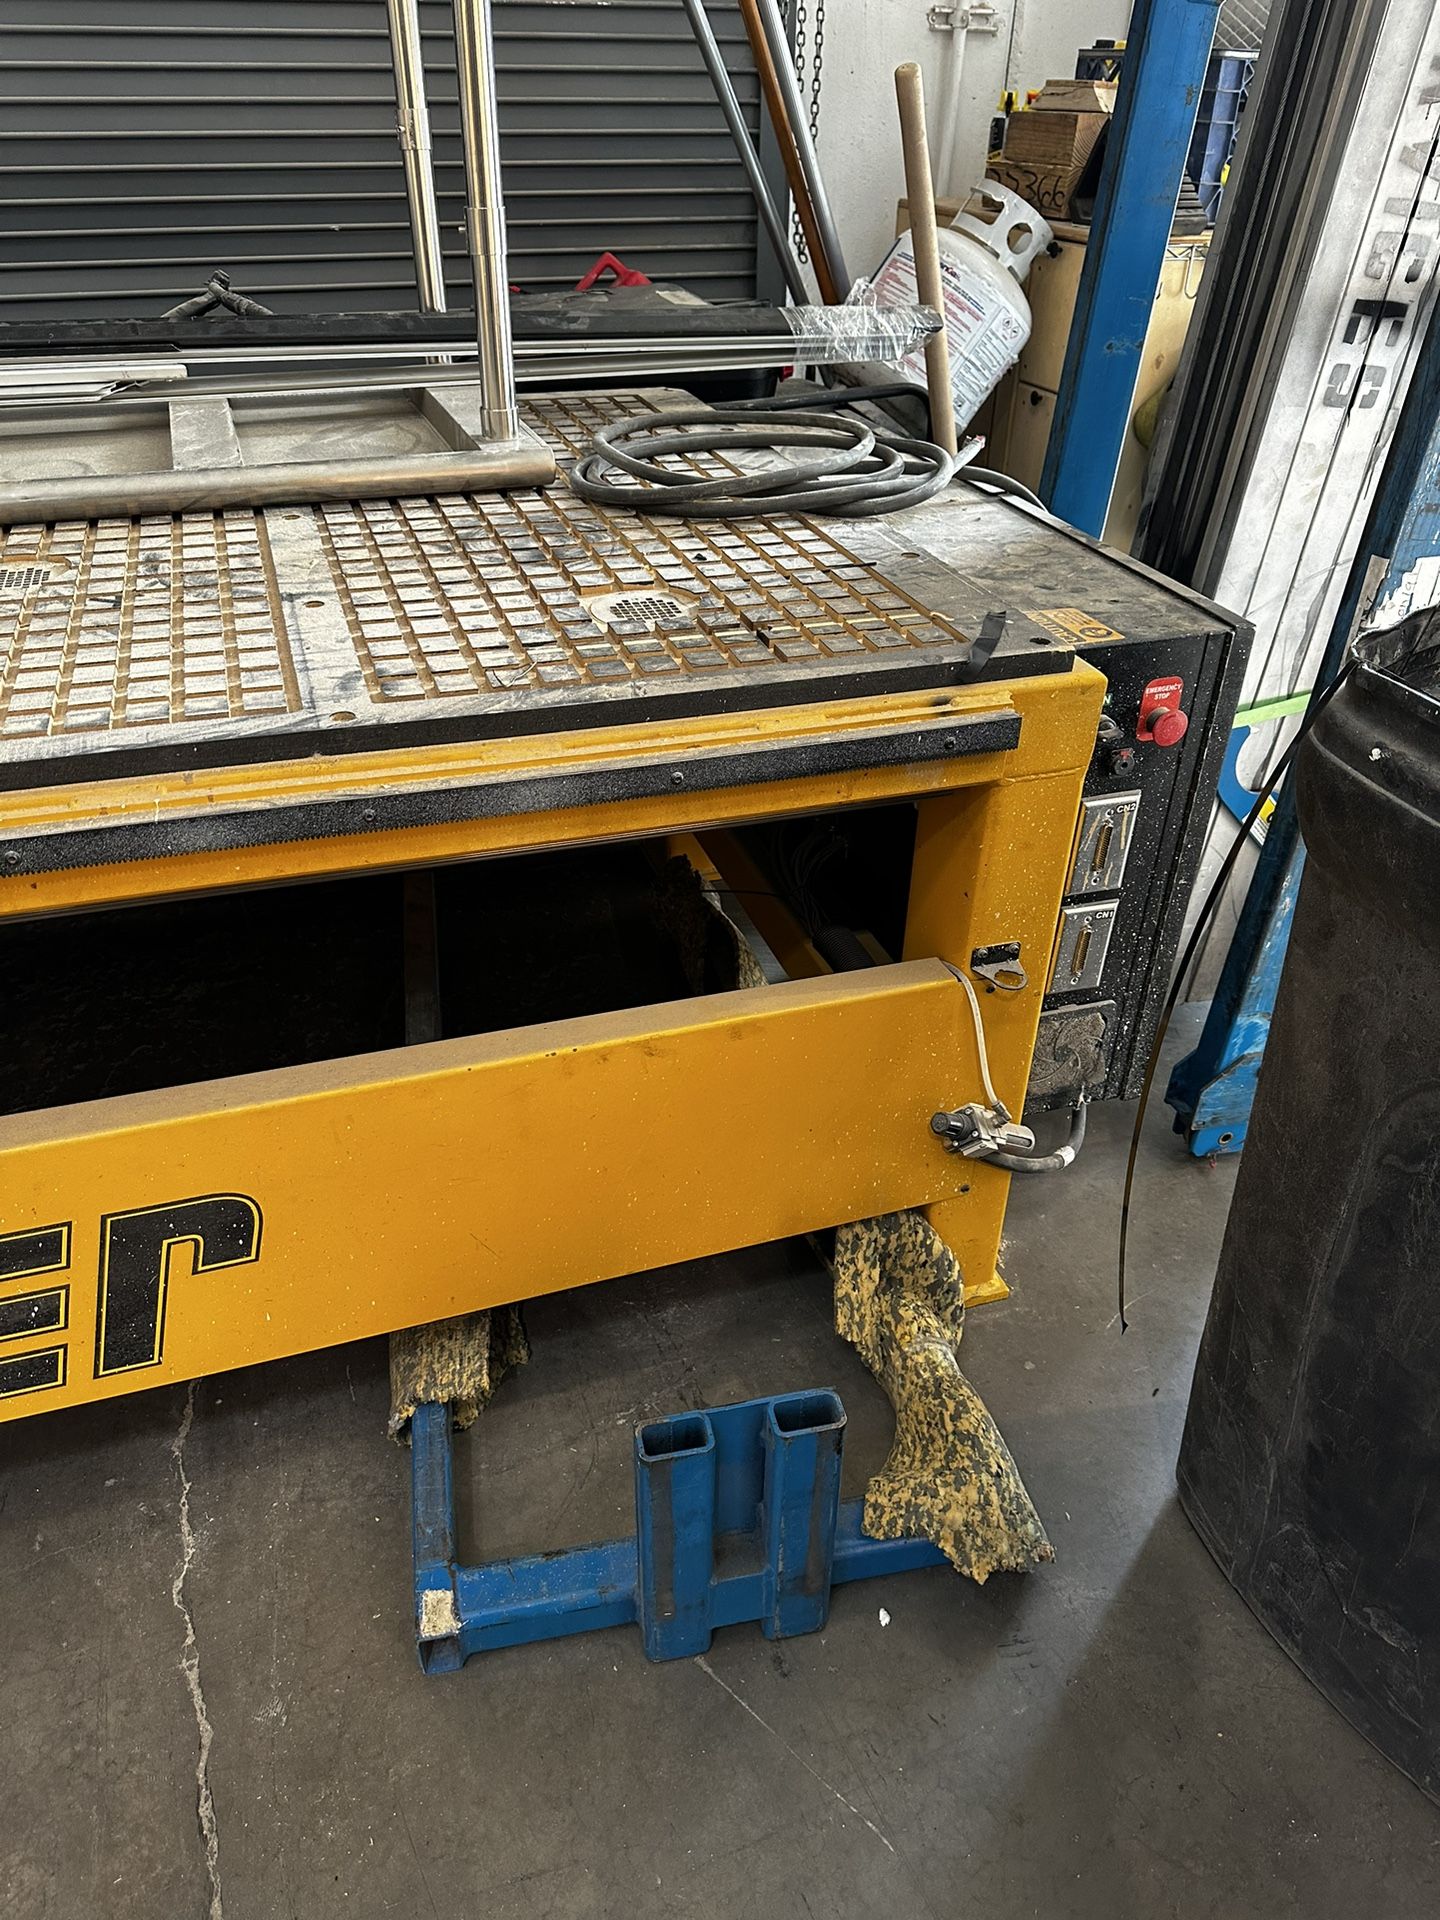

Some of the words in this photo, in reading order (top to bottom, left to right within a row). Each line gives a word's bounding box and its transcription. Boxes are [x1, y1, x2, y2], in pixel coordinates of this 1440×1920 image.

[1145, 683, 1182, 694] EMERGENCY
[1154, 692, 1171, 700] STOP
[1116, 802, 1137, 813] CN2
[1095, 910, 1114, 919] CN1
